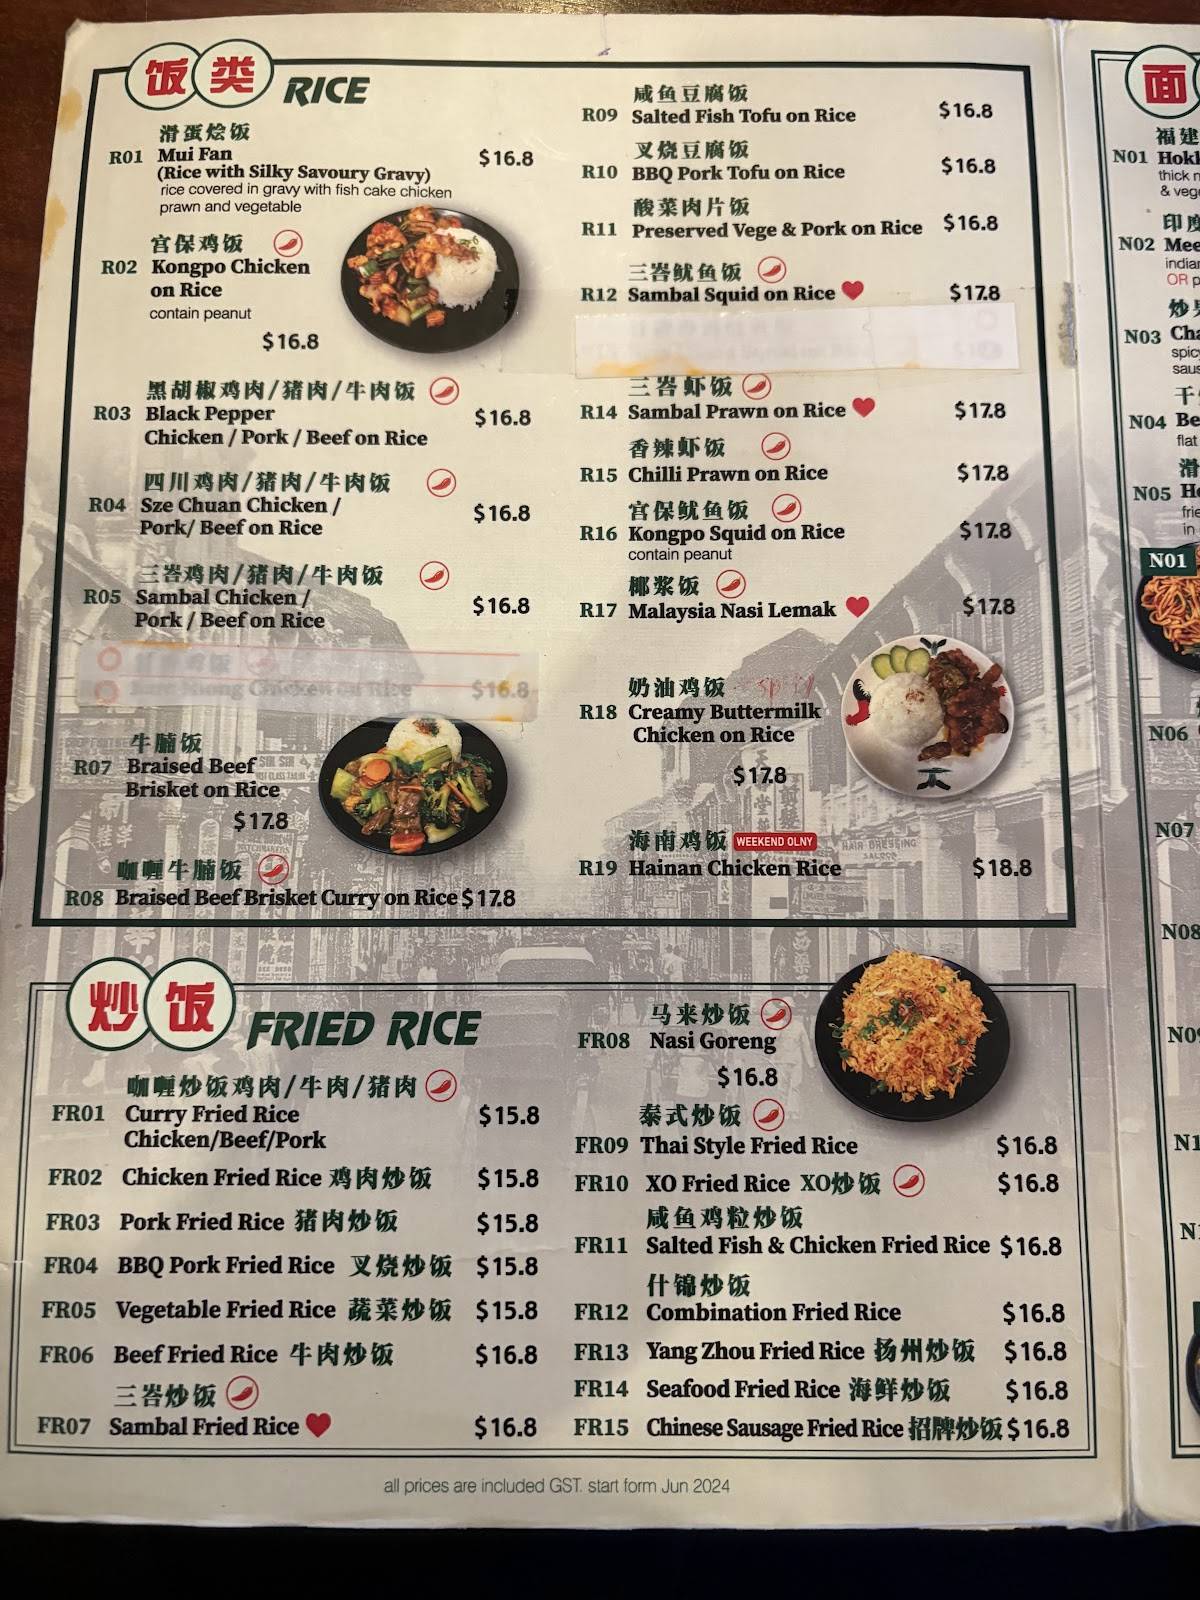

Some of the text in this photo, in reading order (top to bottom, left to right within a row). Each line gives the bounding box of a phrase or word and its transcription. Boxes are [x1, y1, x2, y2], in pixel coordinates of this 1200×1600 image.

[145, 55, 255, 96] 饭类
[284, 77, 370, 106] RICE
[634, 84, 747, 103] 咸鱼豆腐饭
[583, 108, 617, 121] R09
[940, 101, 992, 119] $16.8
[109, 151, 142, 164] R01
[158, 147, 232, 162] Mui Fan
[480, 149, 533, 167] $16.8
[636, 140, 748, 159] 叉烧豆腐饭
[1113, 150, 1147, 163] N01
[158, 164, 430, 185] (Rice with Silky Savoury Gravy)
[582, 165, 617, 179] R10
[942, 157, 995, 175] $16.8
[1159, 170, 1189, 181] thick
[161, 182, 452, 199] rice covered in gravy with fish cake chicken
[160, 202, 301, 215] prawn and vegetable
[634, 197, 749, 217] 酸菜肉片饭
[944, 214, 998, 232] $16.8
[151, 234, 242, 253] 宫保鸡饭
[1119, 237, 1154, 251] N02
[102, 260, 137, 274] R02
[152, 256, 310, 278] Kongpo Chicken
[1167, 272, 1189, 286] OR
[151, 282, 222, 297] on Rice
[582, 288, 616, 301] R12
[950, 284, 1000, 302] $17.8
[150, 308, 251, 321] contain peanut
[263, 332, 318, 351] $16.8
[1125, 330, 1161, 344] N03
[94, 406, 130, 420] R03
[146, 406, 275, 425] Black Pepper
[476, 408, 531, 427] $16.8
[1130, 415, 1166, 429] N04
[630, 437, 725, 458] 香辣虾饭
[1177, 435, 1197, 446] flat
[580, 468, 617, 482] R15
[958, 463, 1008, 482] $17.8
[1133, 487, 1171, 501] N05
[89, 498, 126, 512] R04
[474, 504, 530, 523] $16.8
[629, 500, 748, 521] 宫保鱿鱼饭
[580, 526, 617, 540] R16
[629, 523, 844, 545] Kongpo Squid on Rice
[960, 521, 1011, 540] $17.8
[1184, 526, 1195, 535] in
[629, 549, 732, 563] contain peanut
[1150, 553, 1186, 567] N01
[629, 576, 699, 596] 椰浆饭
[83, 589, 121, 604] R05
[474, 596, 529, 616] $16.8
[580, 603, 617, 617] R17
[629, 601, 837, 623] Malaysia Nasi Lemak
[963, 597, 1015, 617] $17.8
[629, 677, 725, 698] 奶油鸡饭
[580, 705, 616, 719] R18
[629, 703, 821, 724] Creamy Buttermilk
[634, 726, 794, 742] Chicken on Rice
[1149, 726, 1188, 741] N06
[131, 733, 201, 753] 牛腩饭
[74, 760, 111, 775] R07
[127, 757, 203, 774] Braised
[209, 757, 257, 773] Beef
[734, 765, 786, 786] $17.8
[126, 781, 280, 797] Brisket on Rice
[235, 811, 288, 832] $17.8
[1155, 822, 1194, 837] N07
[629, 830, 726, 851] 海南鸡饭
[737, 837, 812, 846] WEEKEND OLNY
[117, 859, 241, 881] 咖喱牛腩饭
[579, 861, 617, 876] R19
[629, 859, 841, 876] Hainan Chicken Rice
[973, 858, 1032, 879] $18.8
[65, 890, 103, 906] R08
[88, 981, 215, 1032] 炒饭
[247, 1011, 481, 1050] FRIED RICE
[578, 1032, 629, 1048] FR08
[650, 1029, 778, 1054] Nasi Goreng
[640, 1104, 740, 1127] 泰式炒饭
[125, 1130, 326, 1151] Chicken/Beef/Pork
[576, 1137, 628, 1153] FR09
[123, 1167, 431, 1189] Chicken Fried Rice 鸡肉炒饭
[575, 1175, 628, 1191] FR10
[646, 1172, 880, 1195] XO Fried Rice XO炒饭
[647, 1206, 802, 1229] 咸鱼鸡粒炒饭
[575, 1237, 627, 1253] FR11
[575, 1344, 628, 1360] FR13
[646, 1338, 975, 1364] Yang Zhou Fried Rice 扬州炒饭
[38, 1417, 90, 1434] FR07
[475, 1416, 536, 1439] $16.8
[384, 1478, 729, 1496] all prices are included GST. start form Jun 2024
